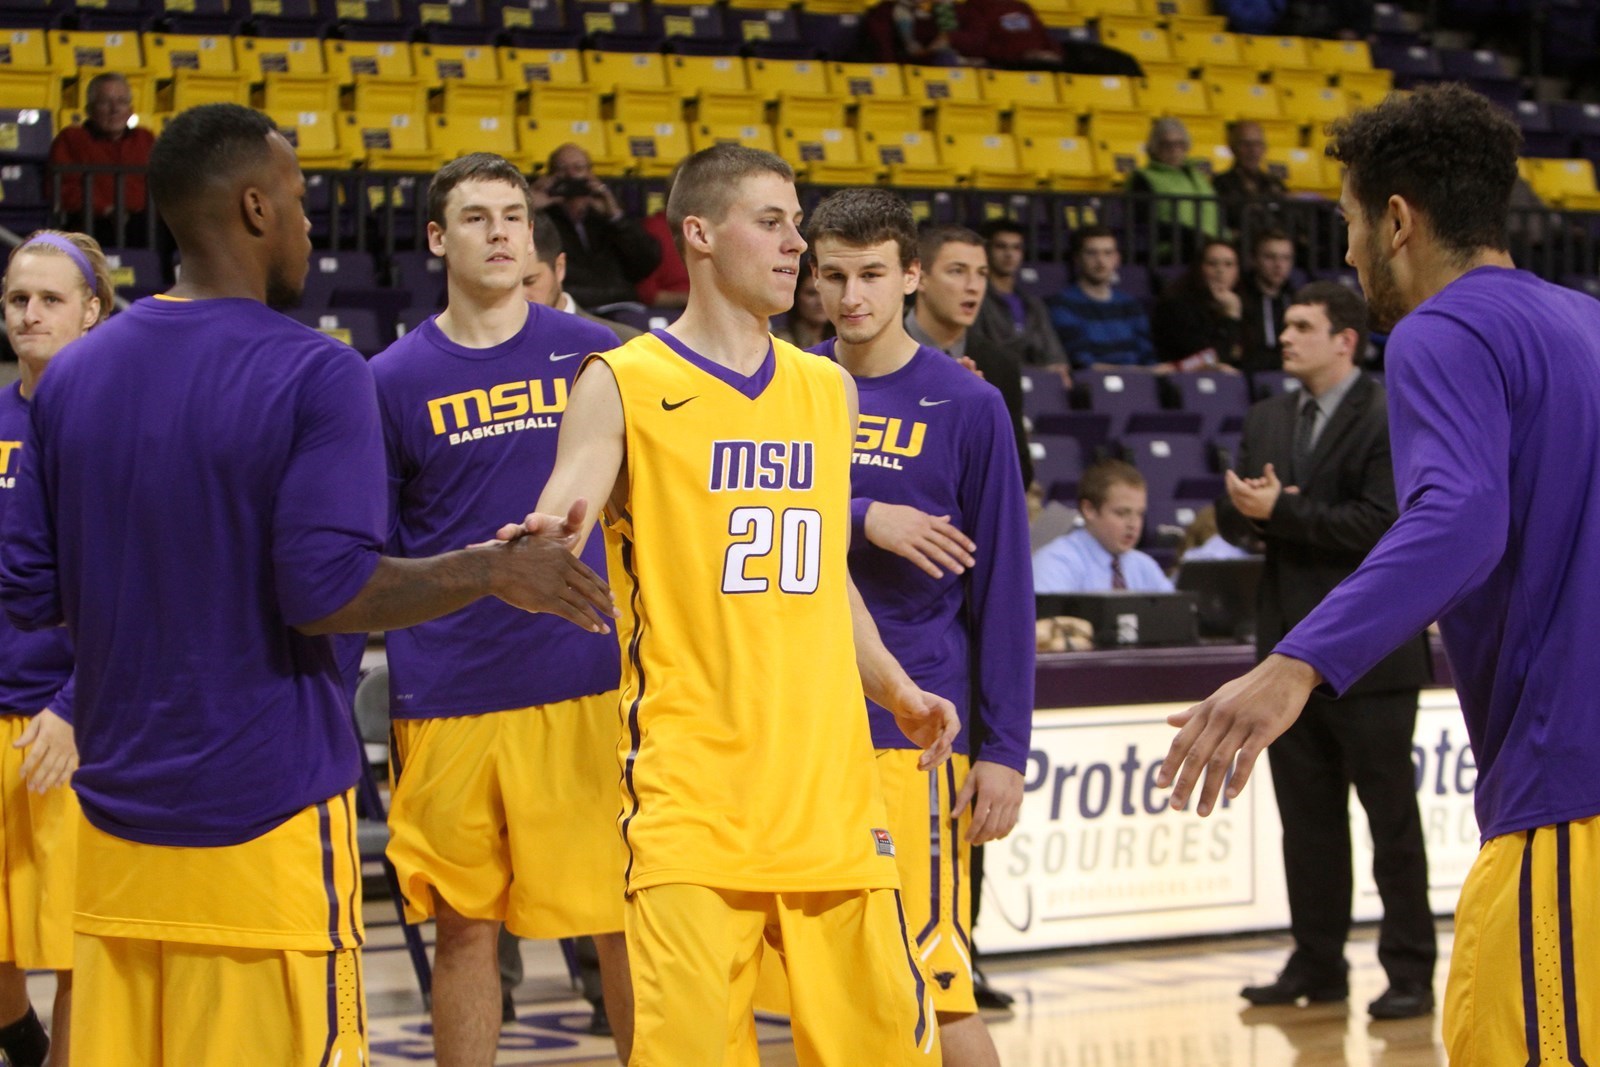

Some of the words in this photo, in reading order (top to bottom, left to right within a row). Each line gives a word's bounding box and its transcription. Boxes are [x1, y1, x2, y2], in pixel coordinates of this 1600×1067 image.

[427, 378, 568, 436] MSU
[449, 416, 557, 445] BASKETBALL
[853, 414, 927, 457] SU
[709, 440, 814, 492] MSU
[721, 506, 822, 594] 20
[1022, 745, 1234, 820] Prote
[1008, 820, 1233, 877] SOURCES
